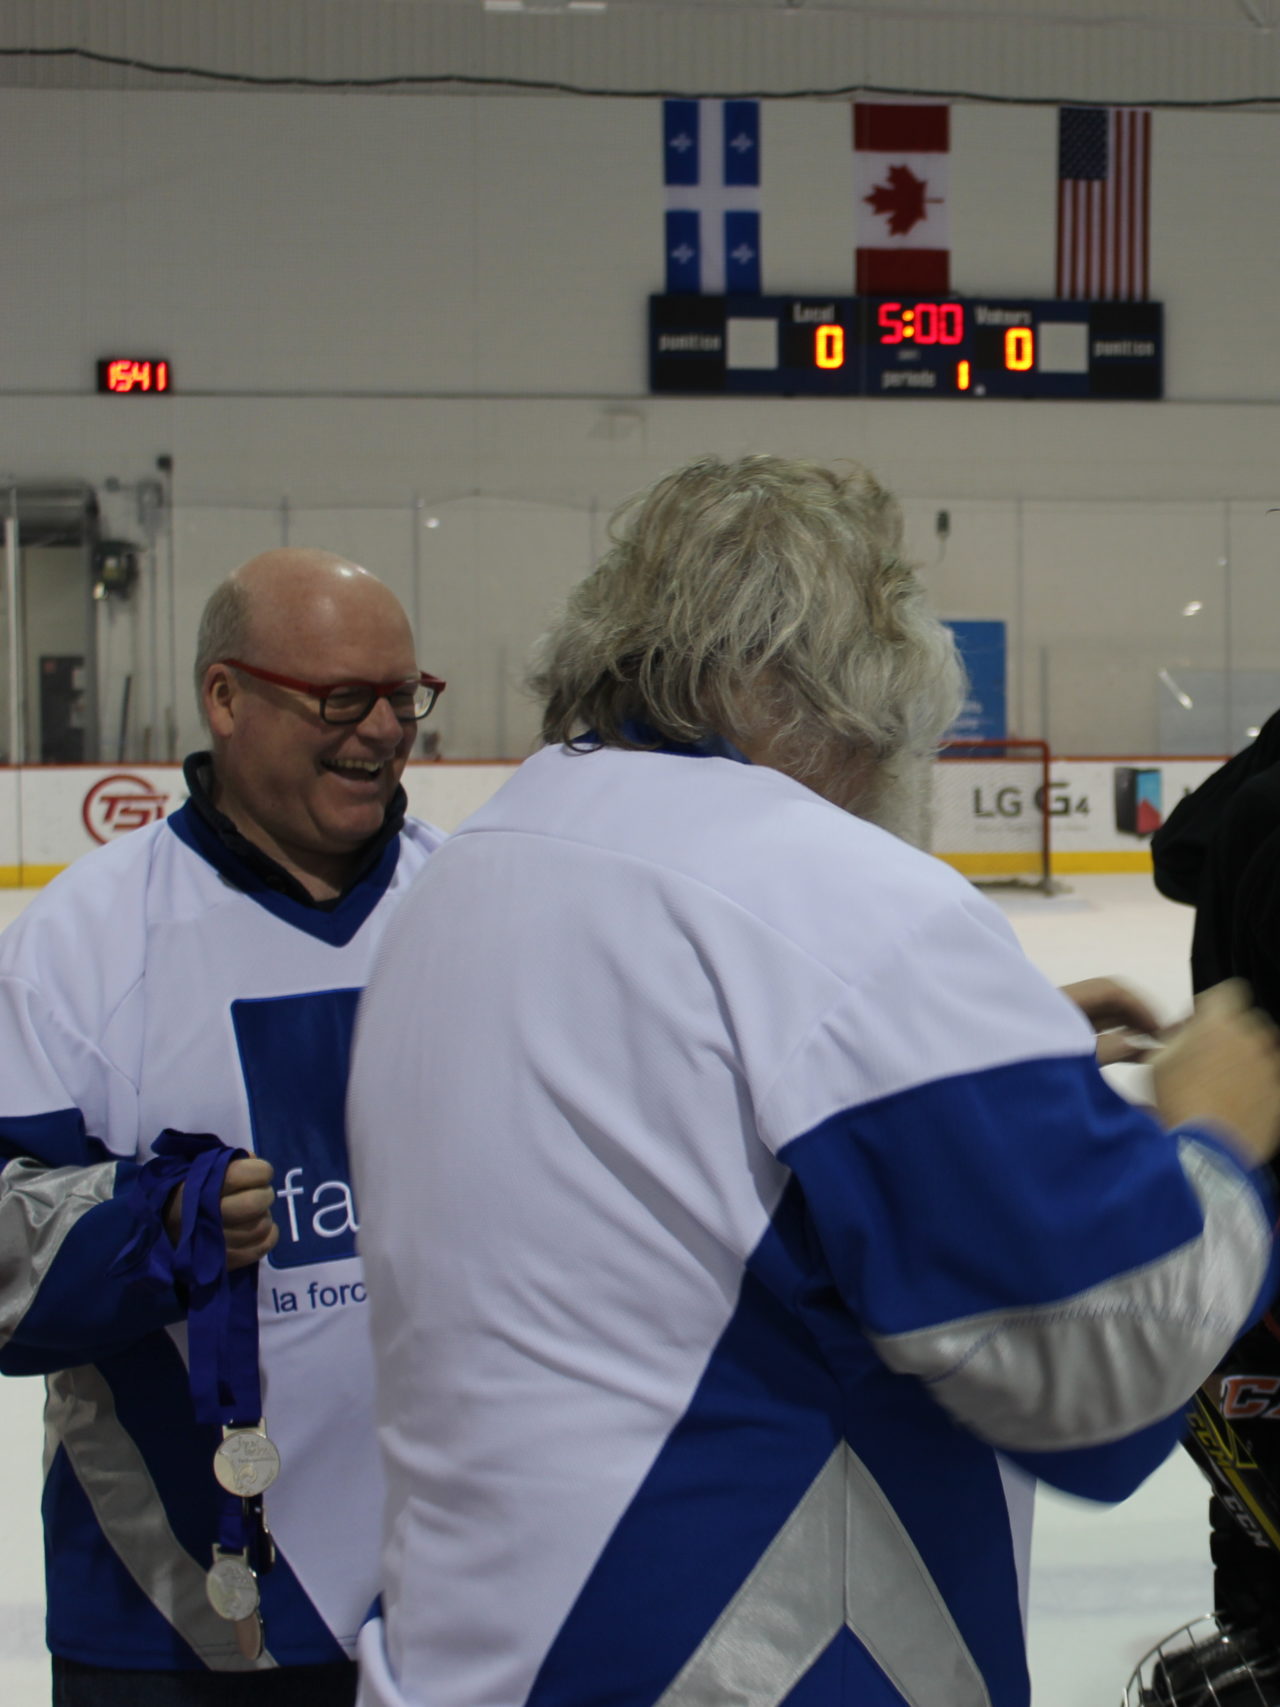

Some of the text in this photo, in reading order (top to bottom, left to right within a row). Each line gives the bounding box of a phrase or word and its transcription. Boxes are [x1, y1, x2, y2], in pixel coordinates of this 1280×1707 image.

[792, 303, 836, 323] Local
[878, 302, 964, 345] 5:00
[658, 333, 722, 352] punition
[815, 324, 844, 369] 0
[1004, 326, 1034, 371] 0
[1094, 340, 1155, 358] punition
[974, 781, 1090, 818] LG G4
[272, 1287, 298, 1314] la
